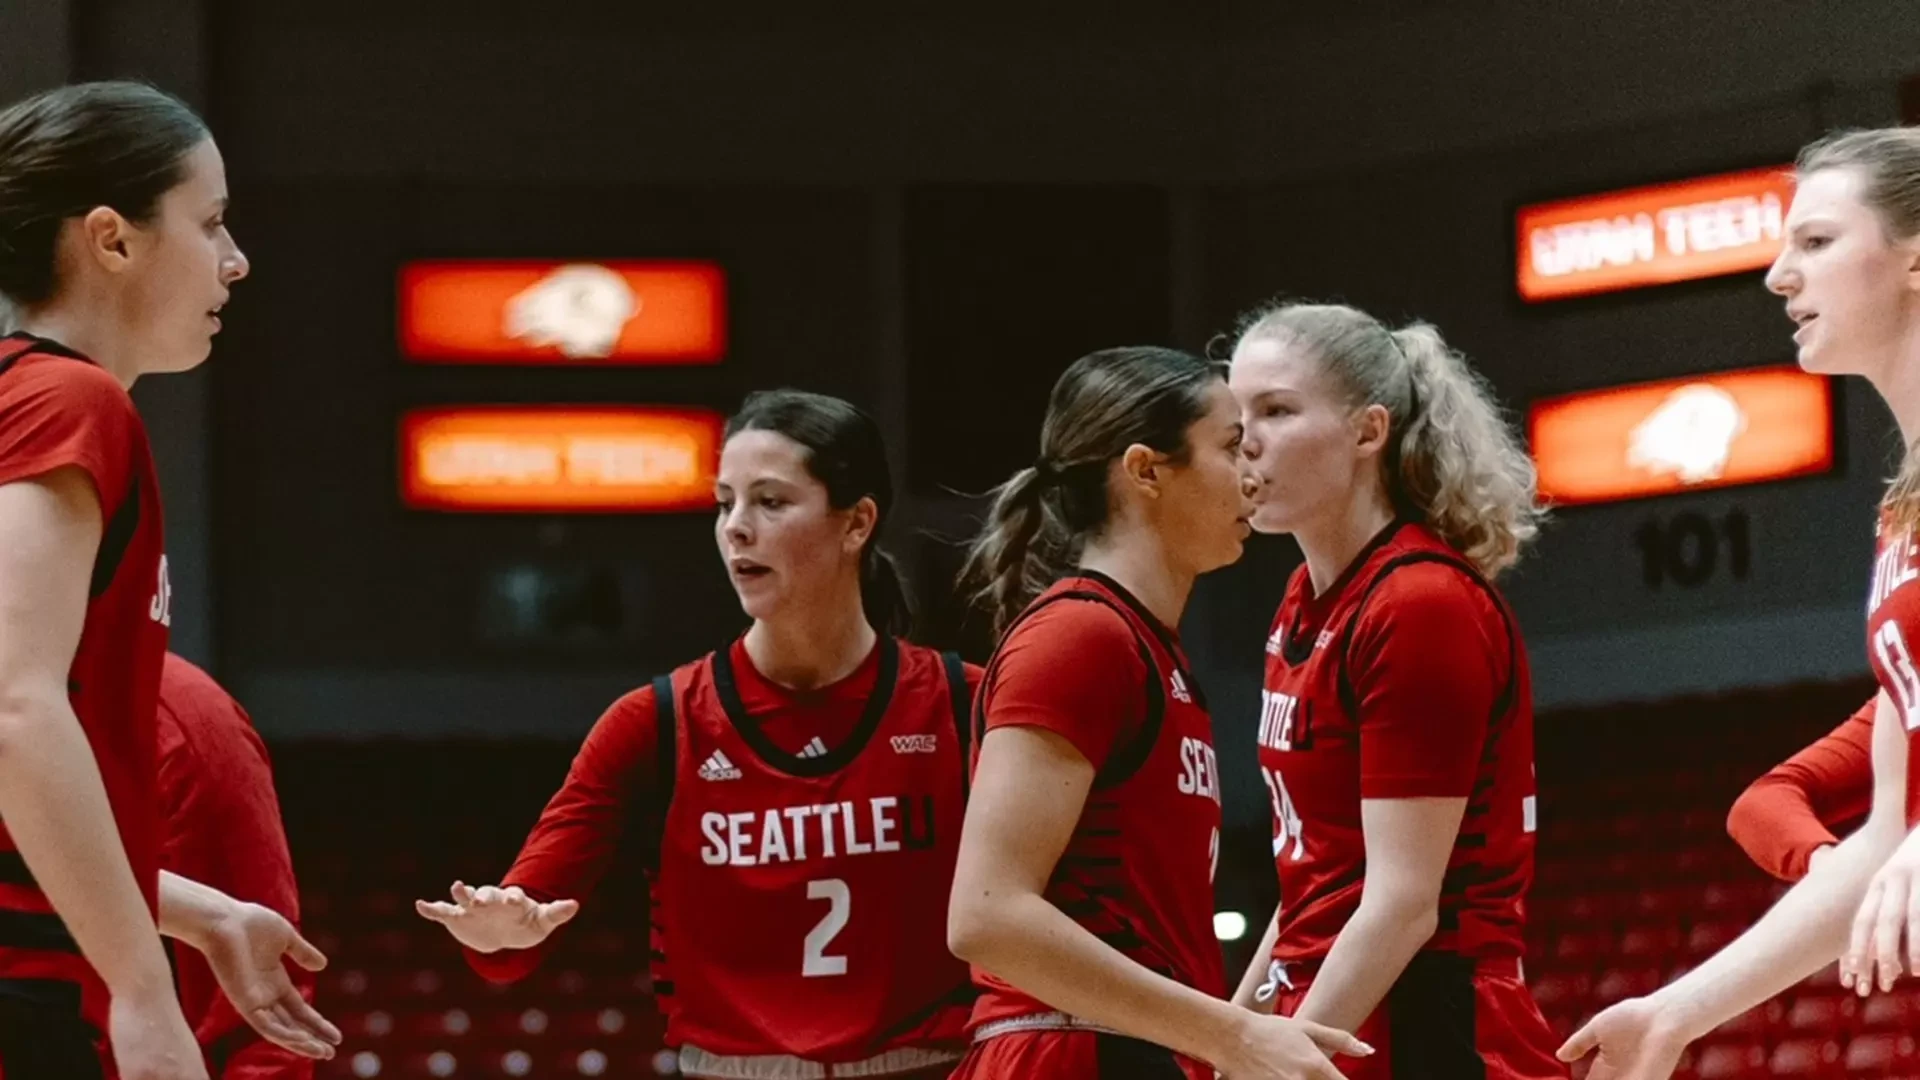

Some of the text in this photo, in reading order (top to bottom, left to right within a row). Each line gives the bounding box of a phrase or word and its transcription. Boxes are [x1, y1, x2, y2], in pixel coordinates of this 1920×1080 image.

[1657, 193, 1782, 257] TECH
[1633, 508, 1751, 590] 101
[890, 735, 937, 754] WAC
[802, 878, 851, 978] 2
